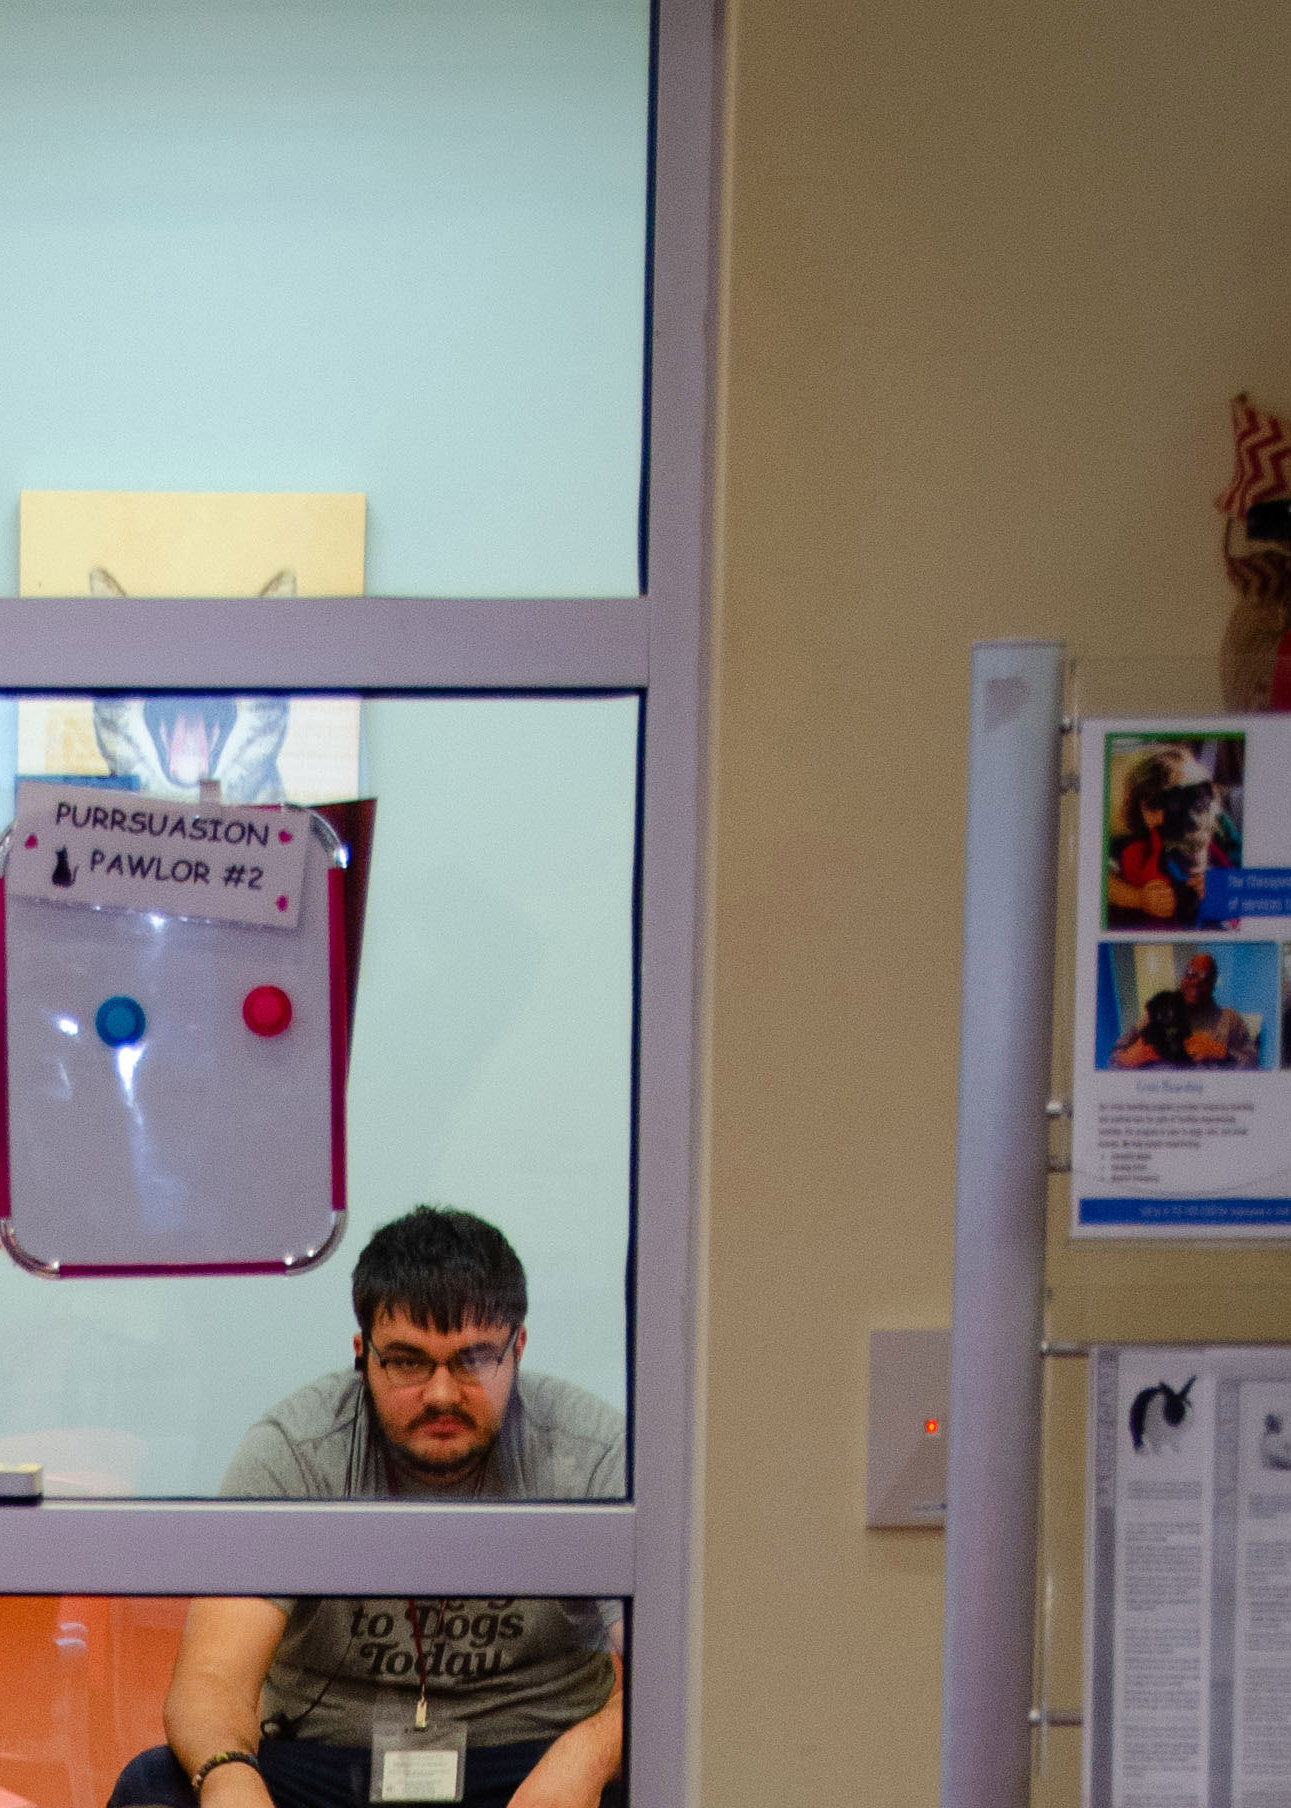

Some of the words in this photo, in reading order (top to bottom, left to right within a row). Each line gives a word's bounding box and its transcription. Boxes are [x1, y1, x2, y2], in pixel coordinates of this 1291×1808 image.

[56, 802, 270, 847] PURRSUASION
[89, 849, 211, 885] PAWLOR
[223, 864, 264, 890] #2
[351, 1606, 394, 1638] to
[359, 1641, 504, 1681] Today
